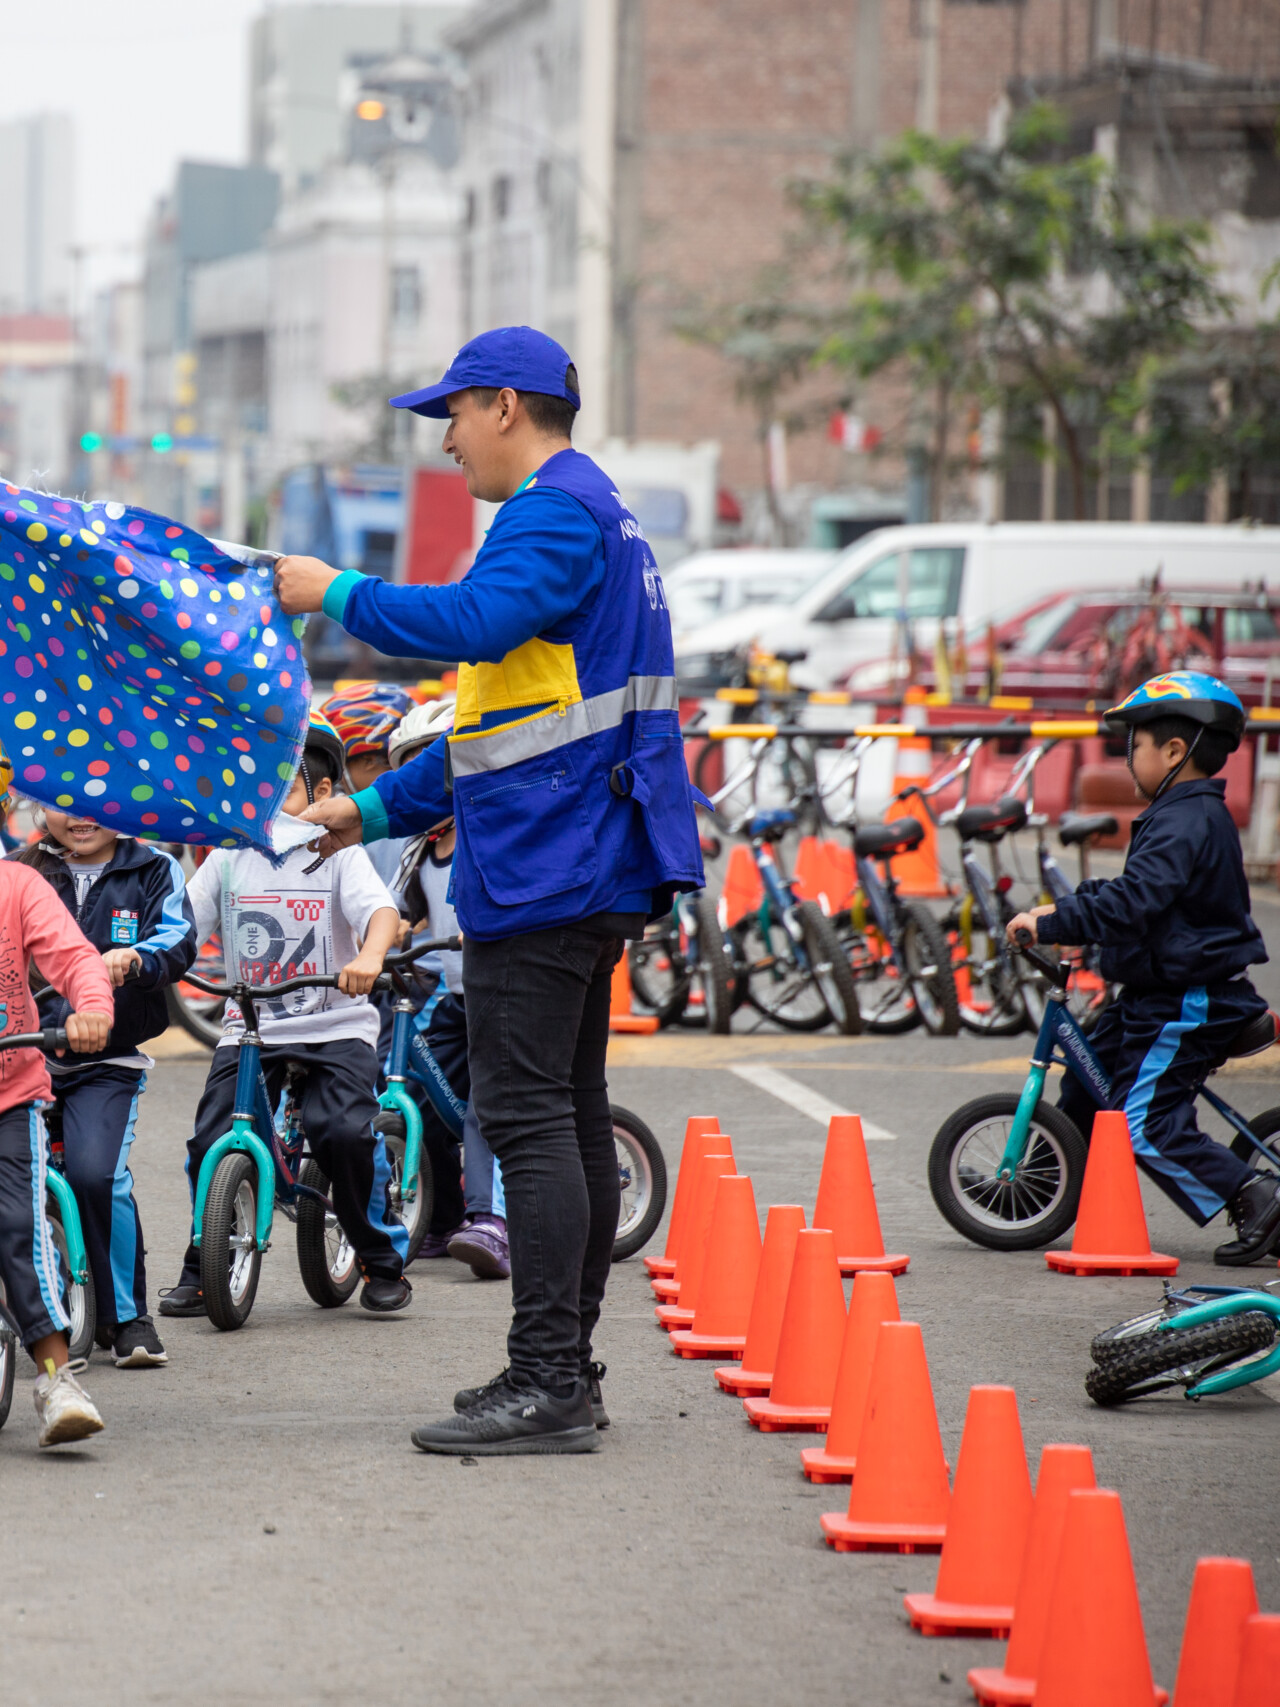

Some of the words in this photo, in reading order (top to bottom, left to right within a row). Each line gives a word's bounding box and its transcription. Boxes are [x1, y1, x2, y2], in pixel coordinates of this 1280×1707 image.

[246, 927, 260, 955] ONE
[239, 960, 317, 985] URBAN
[420, 1046, 452, 1098] MUNICIPALIDAD
[448, 1095, 458, 1107] DE
